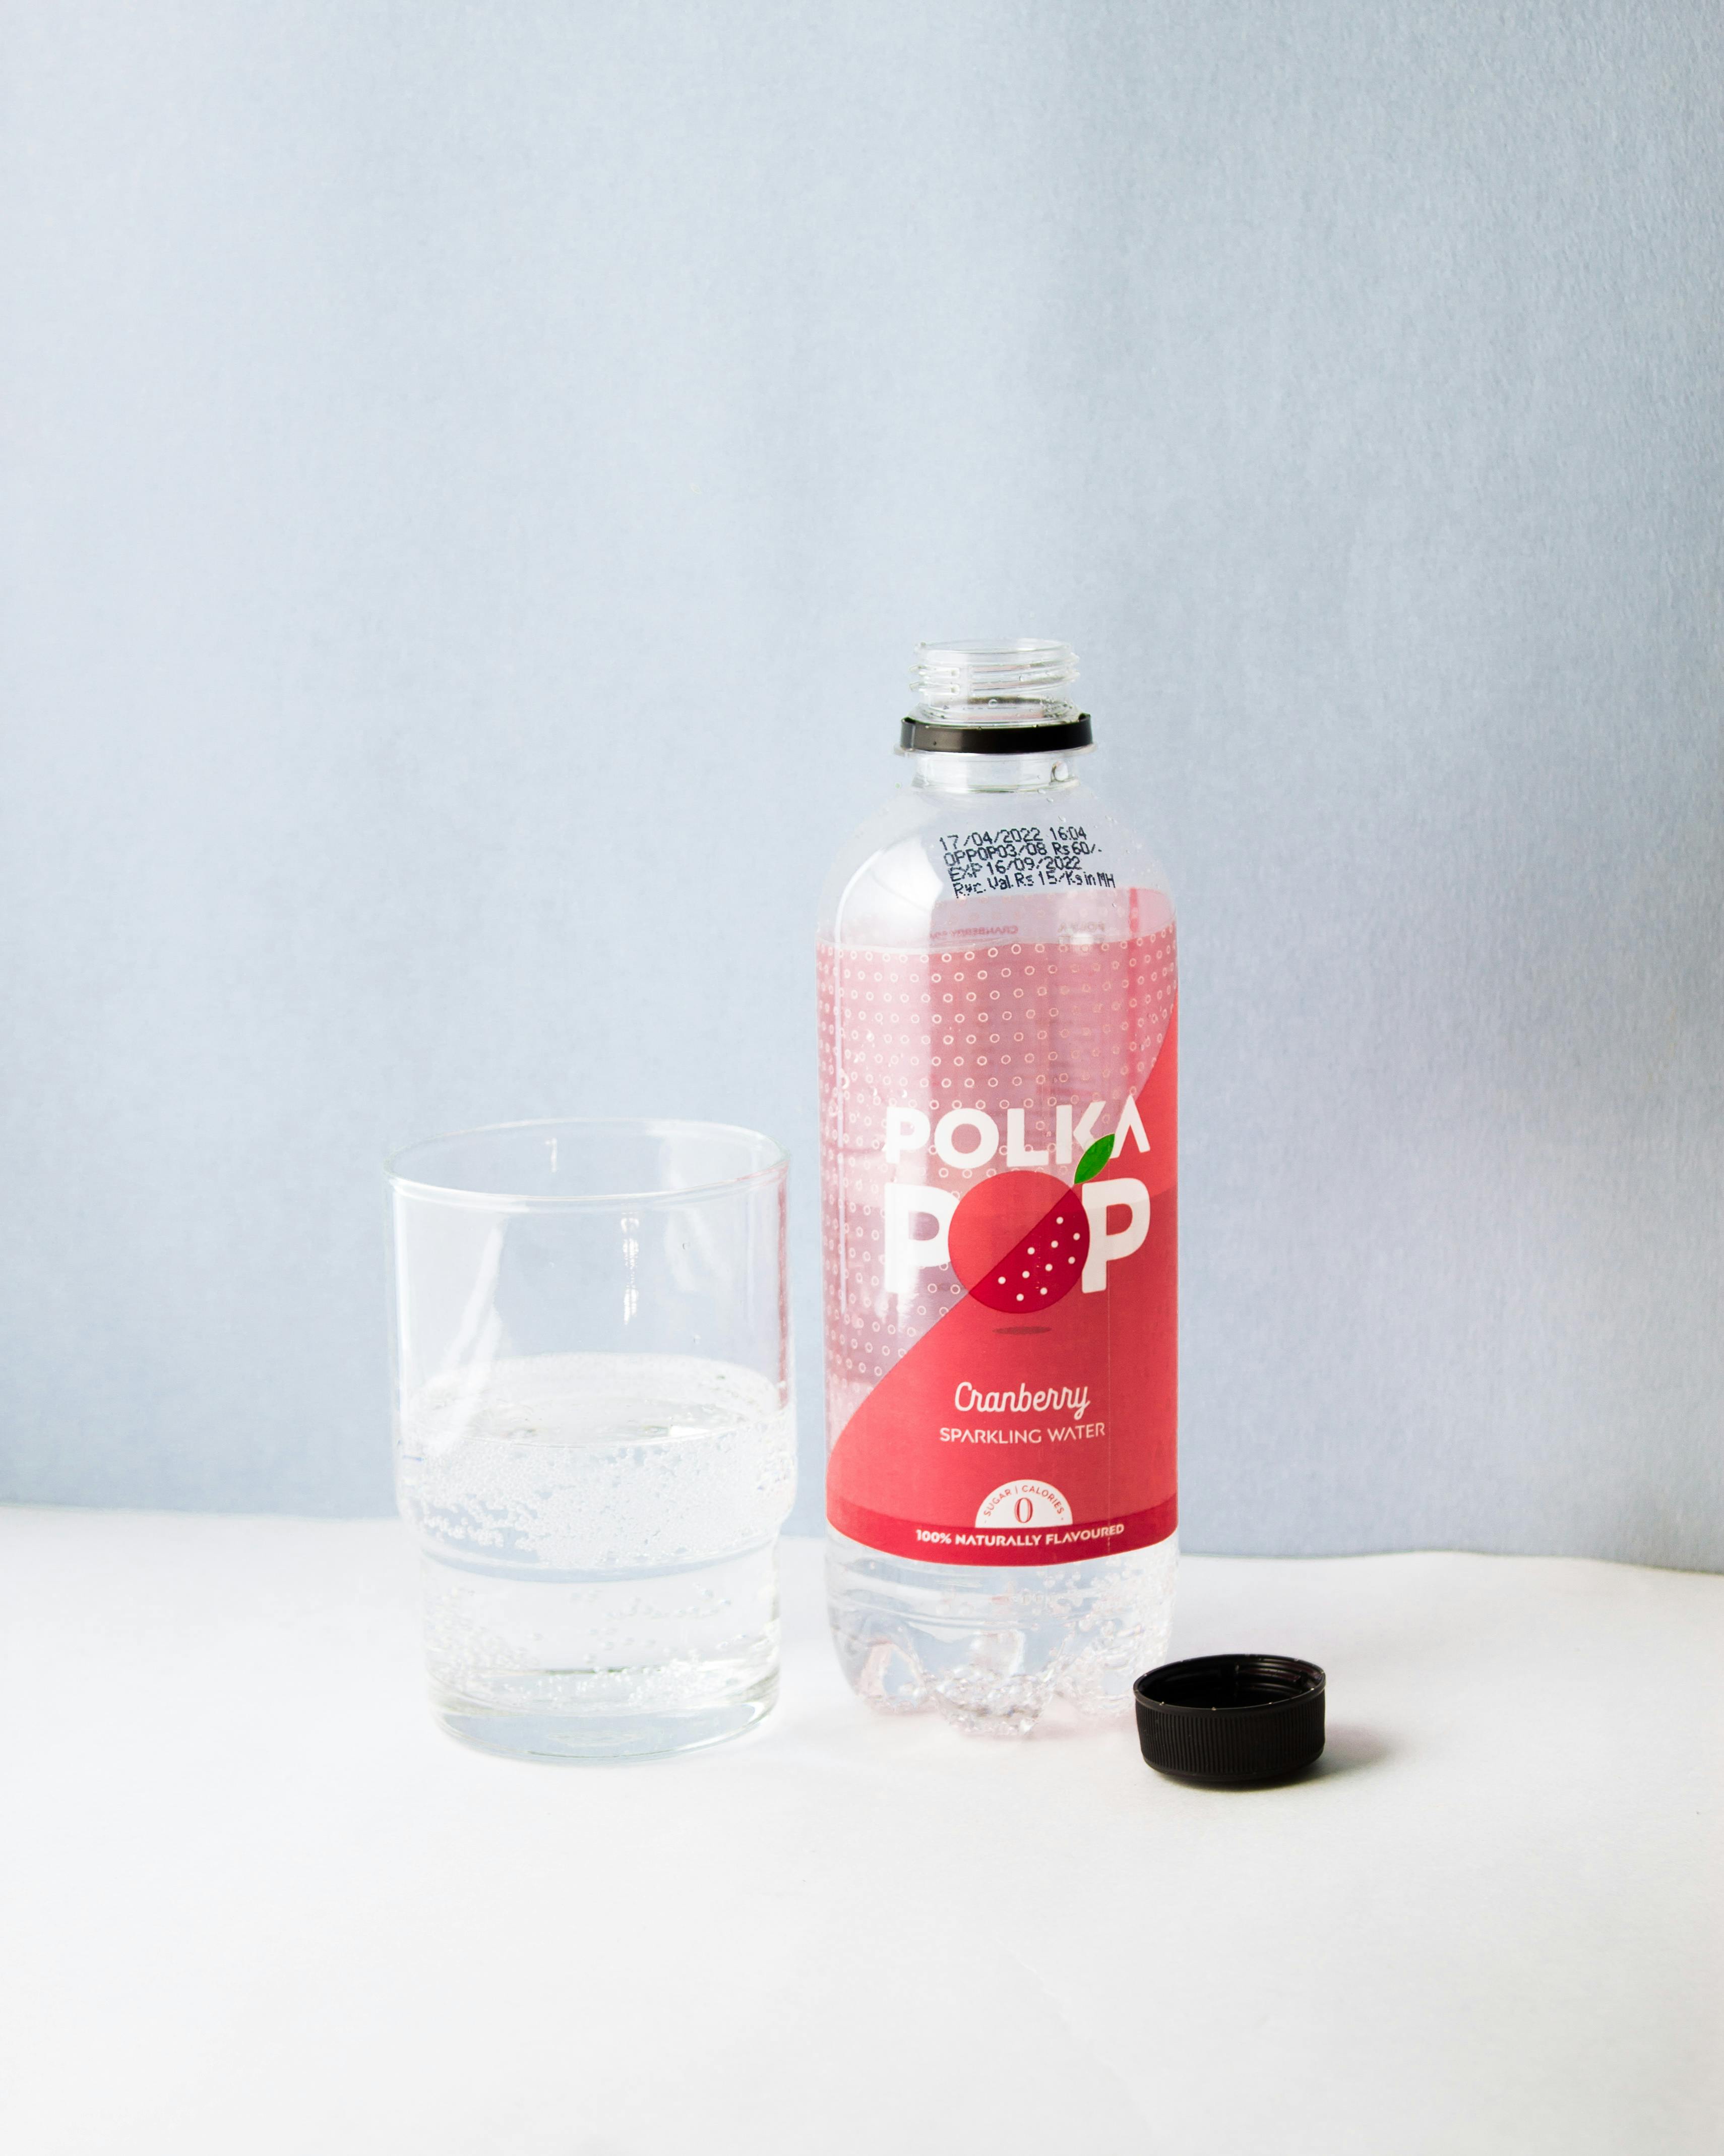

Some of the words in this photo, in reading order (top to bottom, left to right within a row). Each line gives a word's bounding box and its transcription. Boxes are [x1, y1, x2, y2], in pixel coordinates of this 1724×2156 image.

[939, 827, 1043, 851] 17/04/2022
[1050, 826, 1087, 841] 16:04
[948, 863, 983, 882] EXP
[986, 856, 1083, 875] 16/09/2022
[885, 1094, 1150, 1169] POLKA
[954, 1381, 1091, 1420] Cranberry
[940, 1427, 1042, 1444] SPARKLING
[1046, 1422, 1106, 1443] WATER
[983, 1488, 1012, 1517] SUGAR
[1021, 1484, 1065, 1515] CALORIES
[915, 1529, 952, 1545] 100%
[955, 1533, 1041, 1547] NATURALLY
[1044, 1523, 1125, 1545] FLAVOURED
